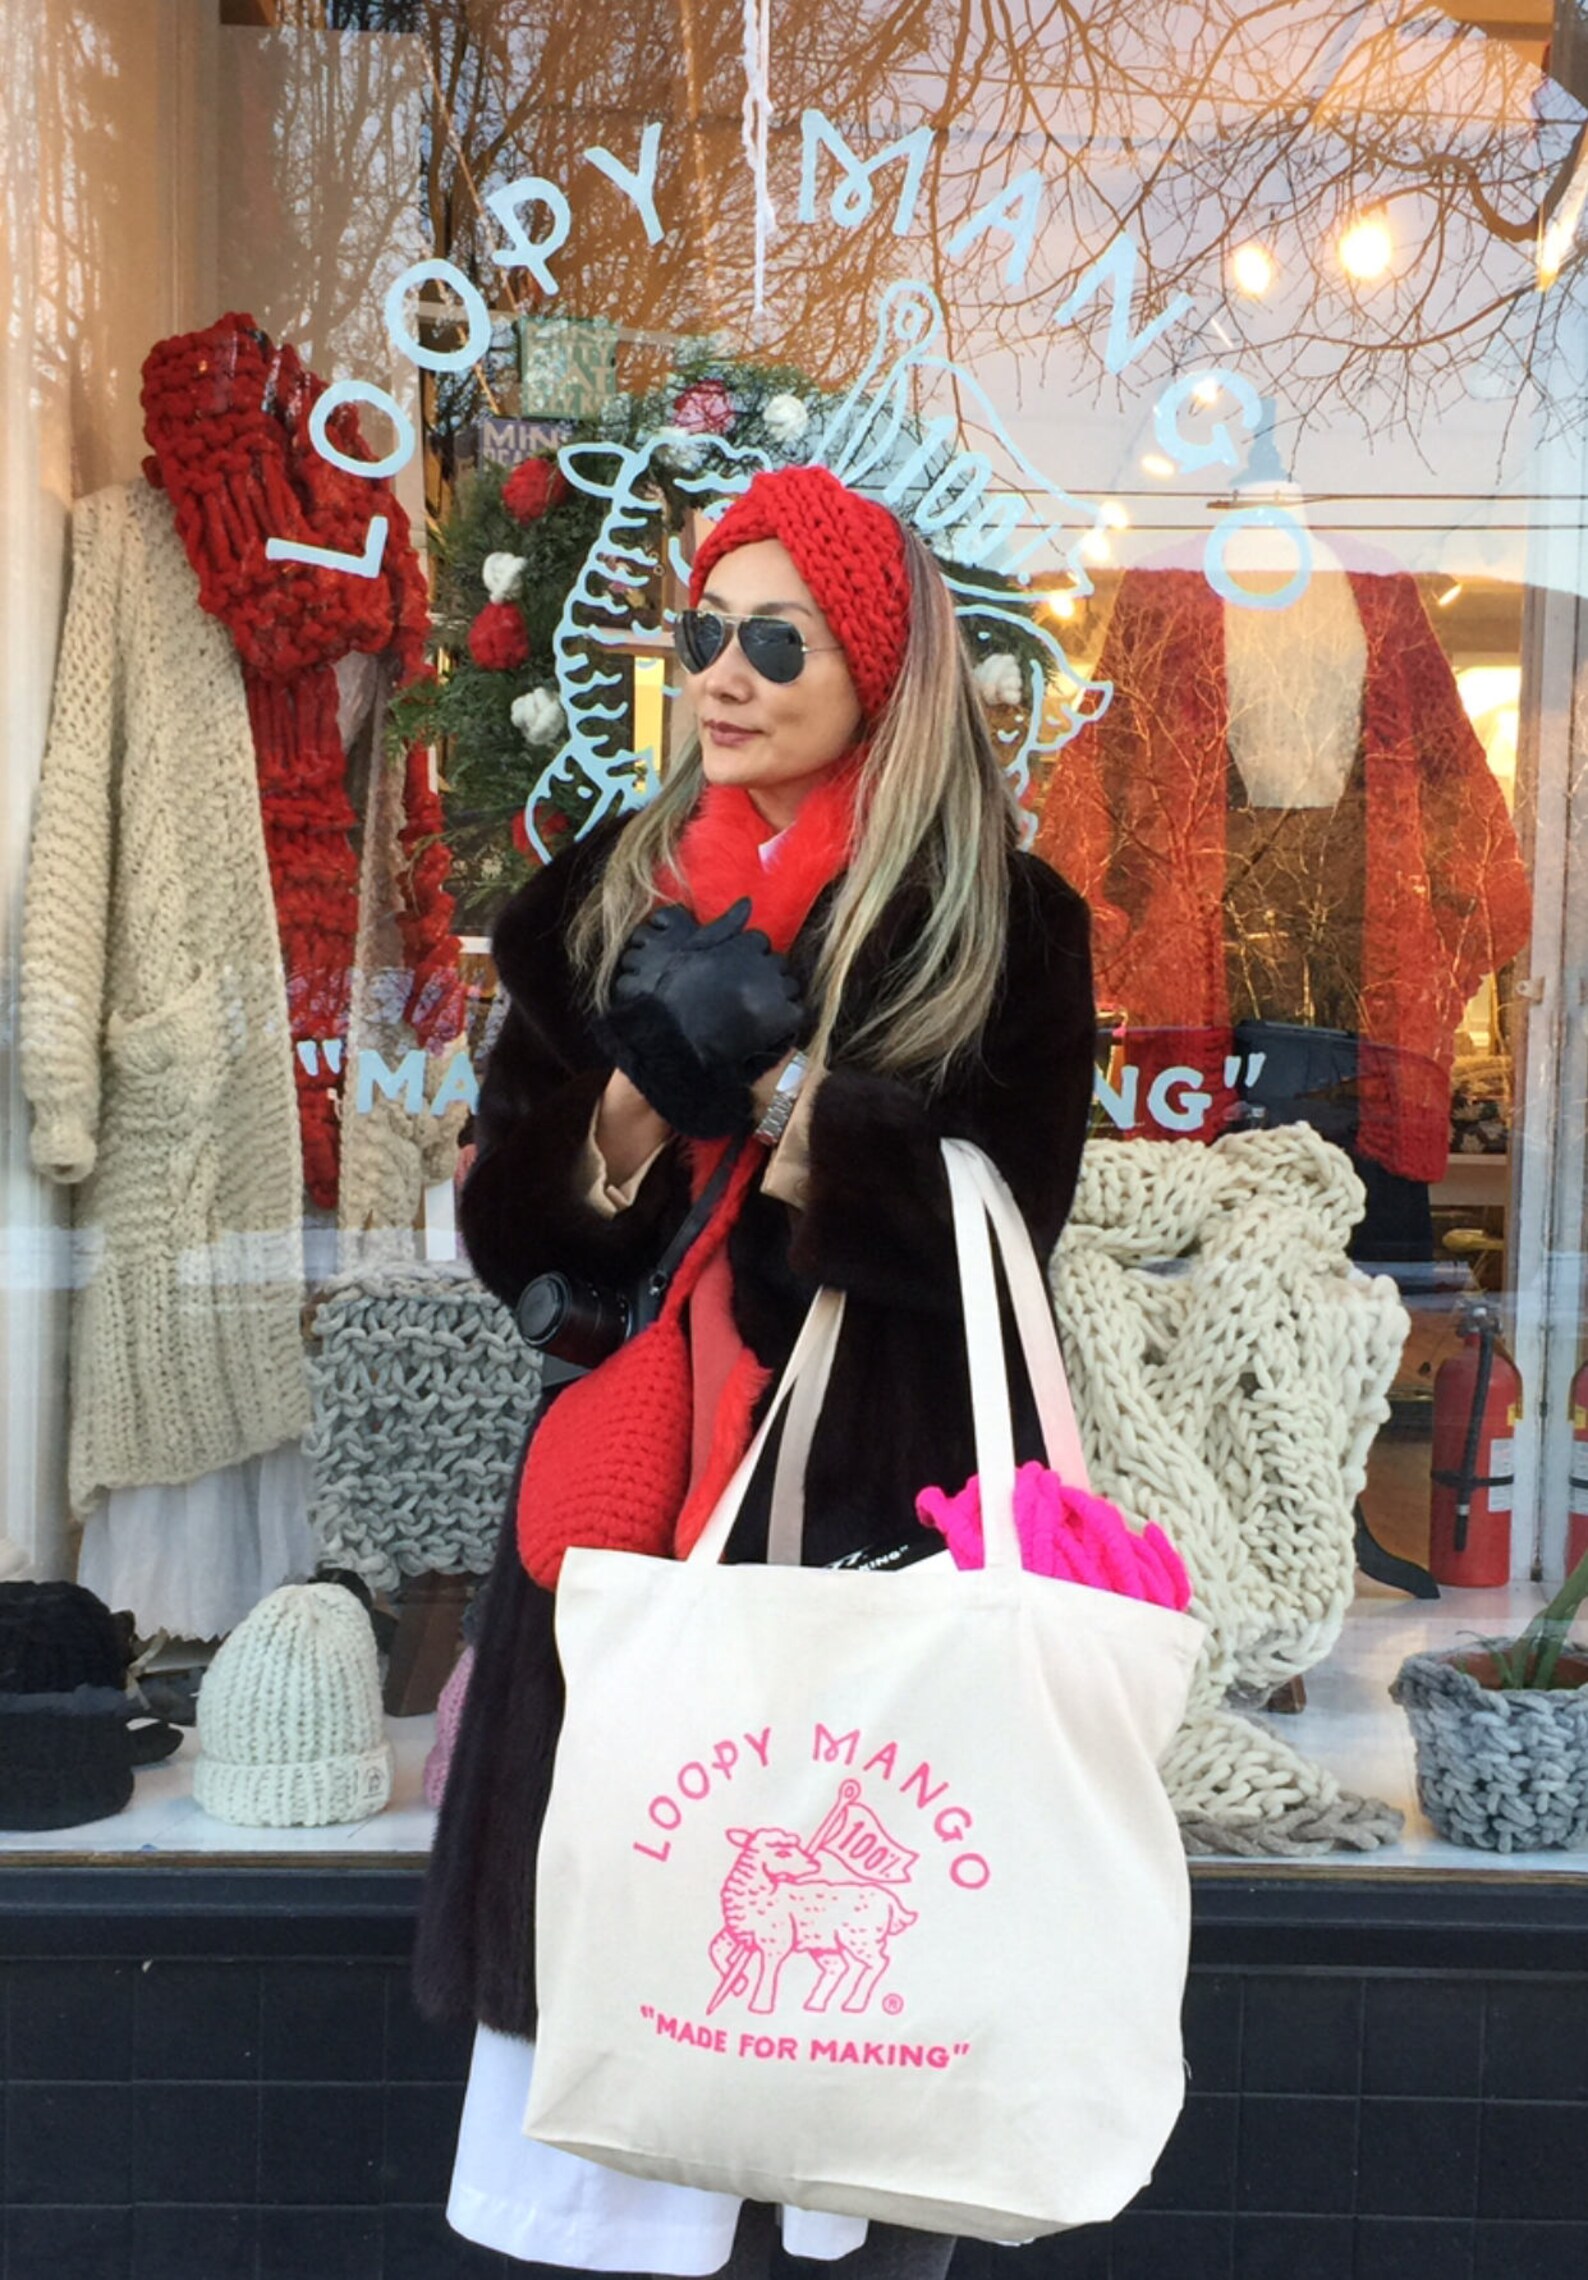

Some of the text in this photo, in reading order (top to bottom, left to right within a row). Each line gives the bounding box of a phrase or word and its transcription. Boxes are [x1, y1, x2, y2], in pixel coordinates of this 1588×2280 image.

[265, 108, 1312, 610] LOOPY MANGO
[633, 1723, 990, 1889] LOOPY MANGO
[839, 1821, 901, 1878] 100%
[640, 2005, 970, 2069] "MADE FOR MAKING"
